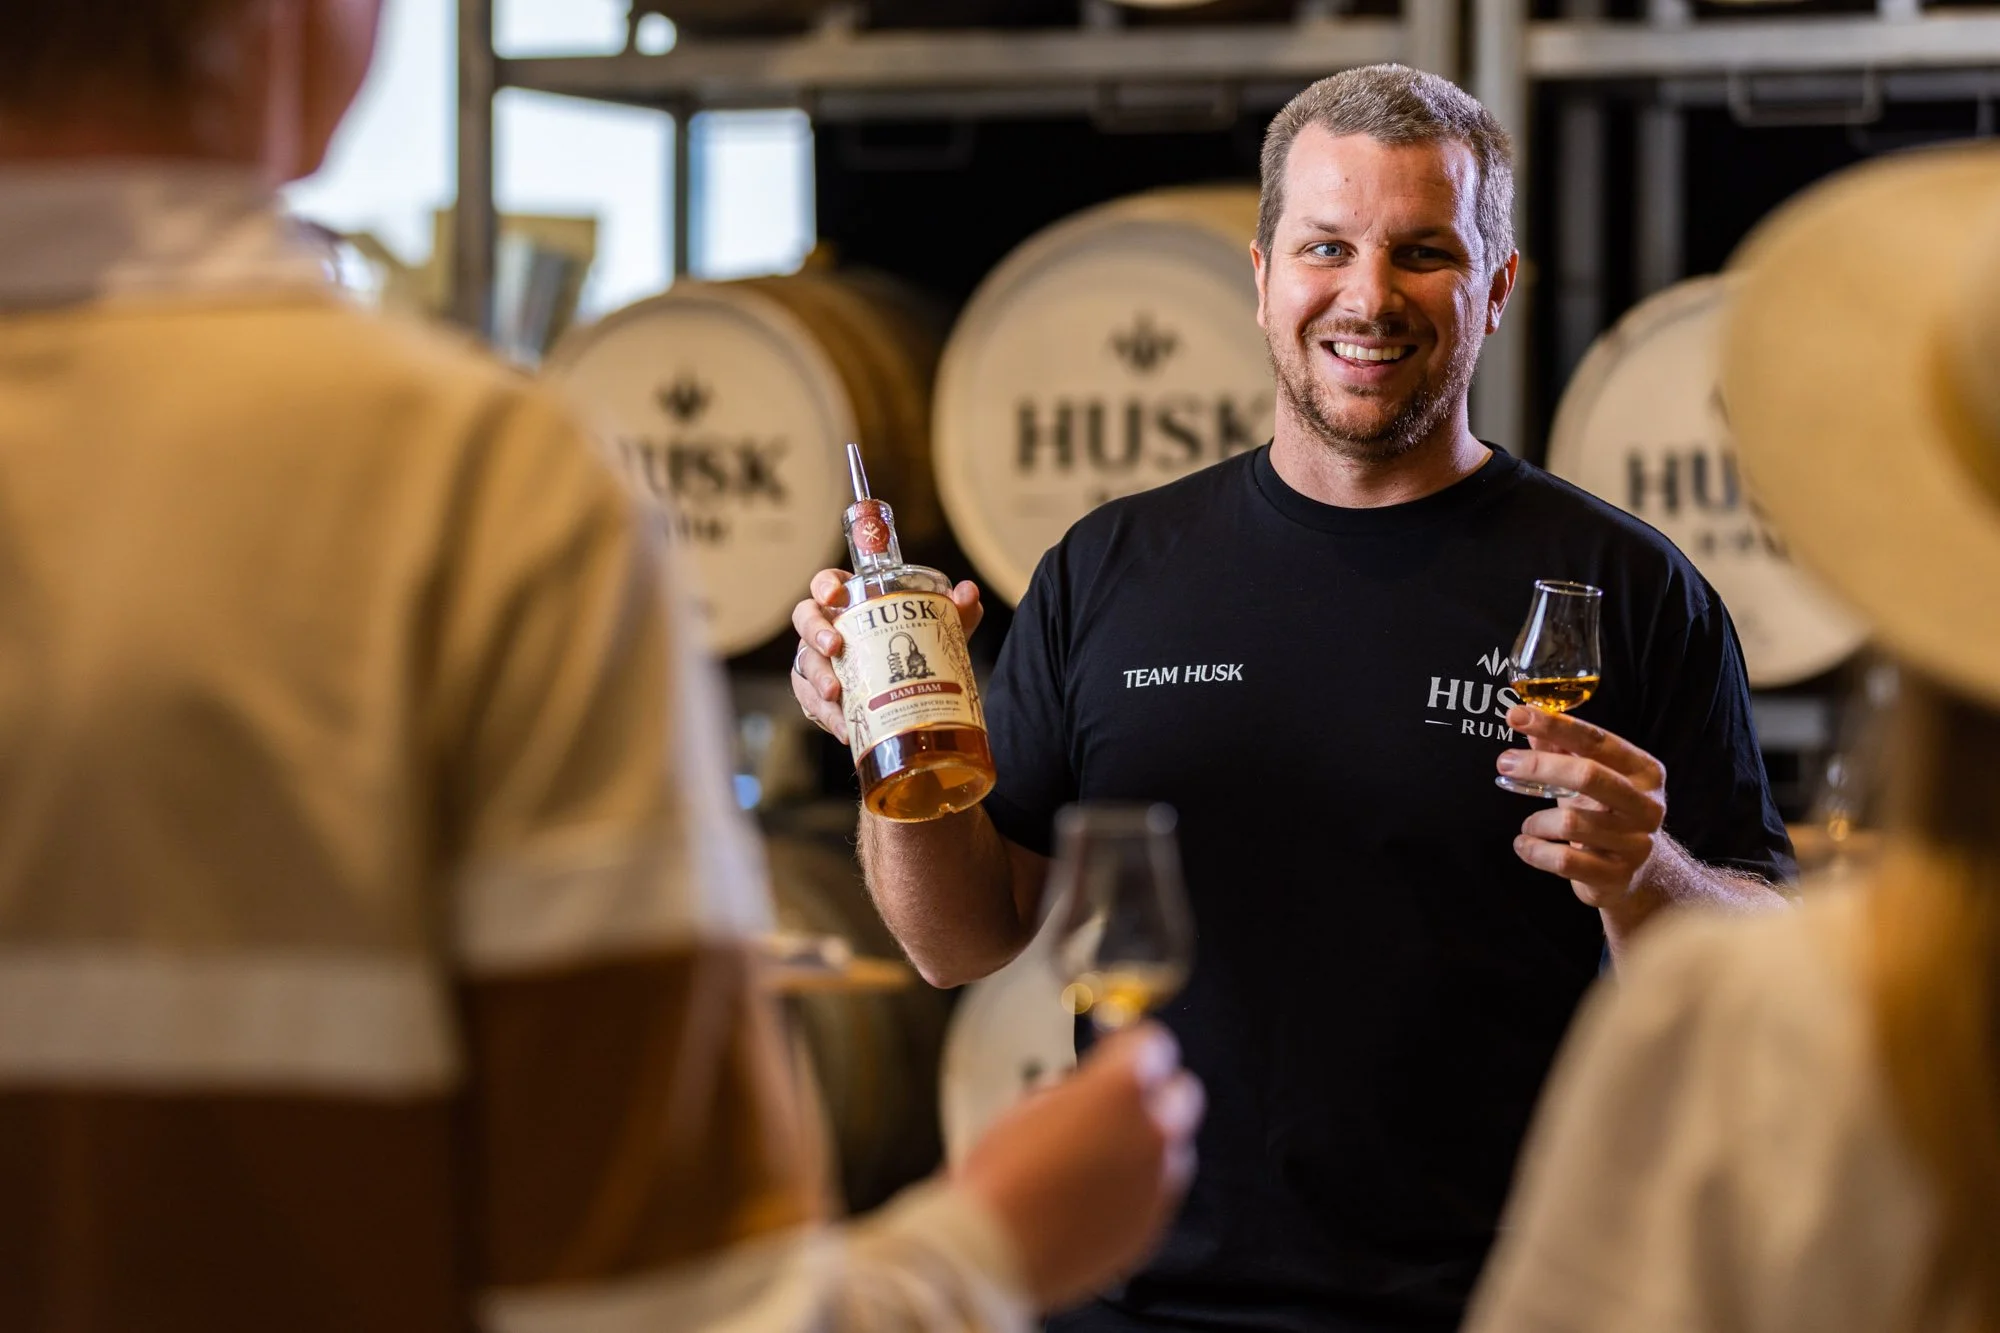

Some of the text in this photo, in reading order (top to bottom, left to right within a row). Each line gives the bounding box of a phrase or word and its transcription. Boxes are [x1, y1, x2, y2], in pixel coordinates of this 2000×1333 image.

[1016, 393, 1274, 475] HUSK
[618, 435, 790, 507] USK
[855, 600, 939, 635] HUSK
[874, 622, 928, 637] DISTILLERS
[1123, 663, 1244, 689] TEAM HUSK
[889, 683, 941, 701] BAM BAM
[1427, 676, 1521, 719] HUS
[880, 703, 919, 719] AUSTRALIAN
[920, 699, 945, 708] SPICED
[1461, 718, 1514, 743] RUM
